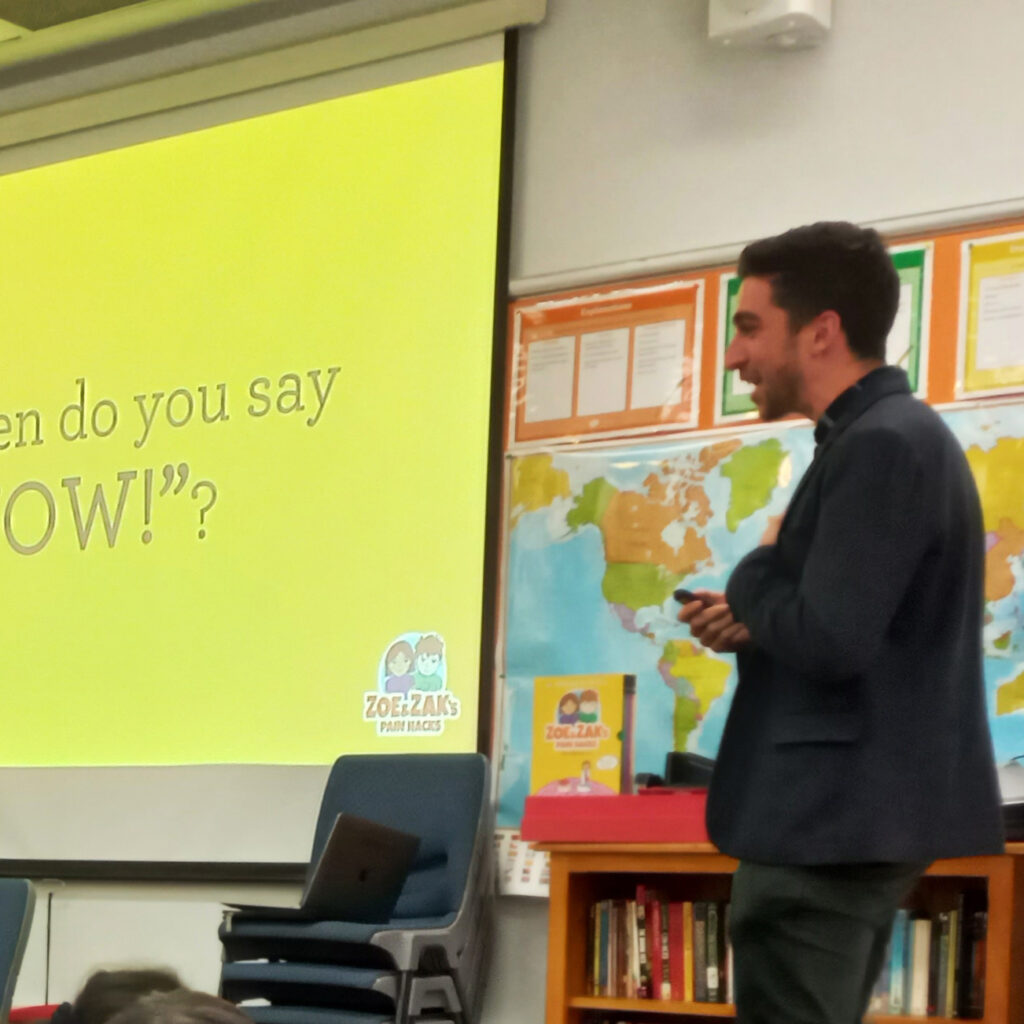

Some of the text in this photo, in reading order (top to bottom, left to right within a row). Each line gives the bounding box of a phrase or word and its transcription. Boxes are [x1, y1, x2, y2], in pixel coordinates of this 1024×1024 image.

[59, 378, 118, 442] do
[134, 379, 230, 448] you
[247, 366, 342, 428] say
[380, 720, 442, 733] PAIN HACKS
